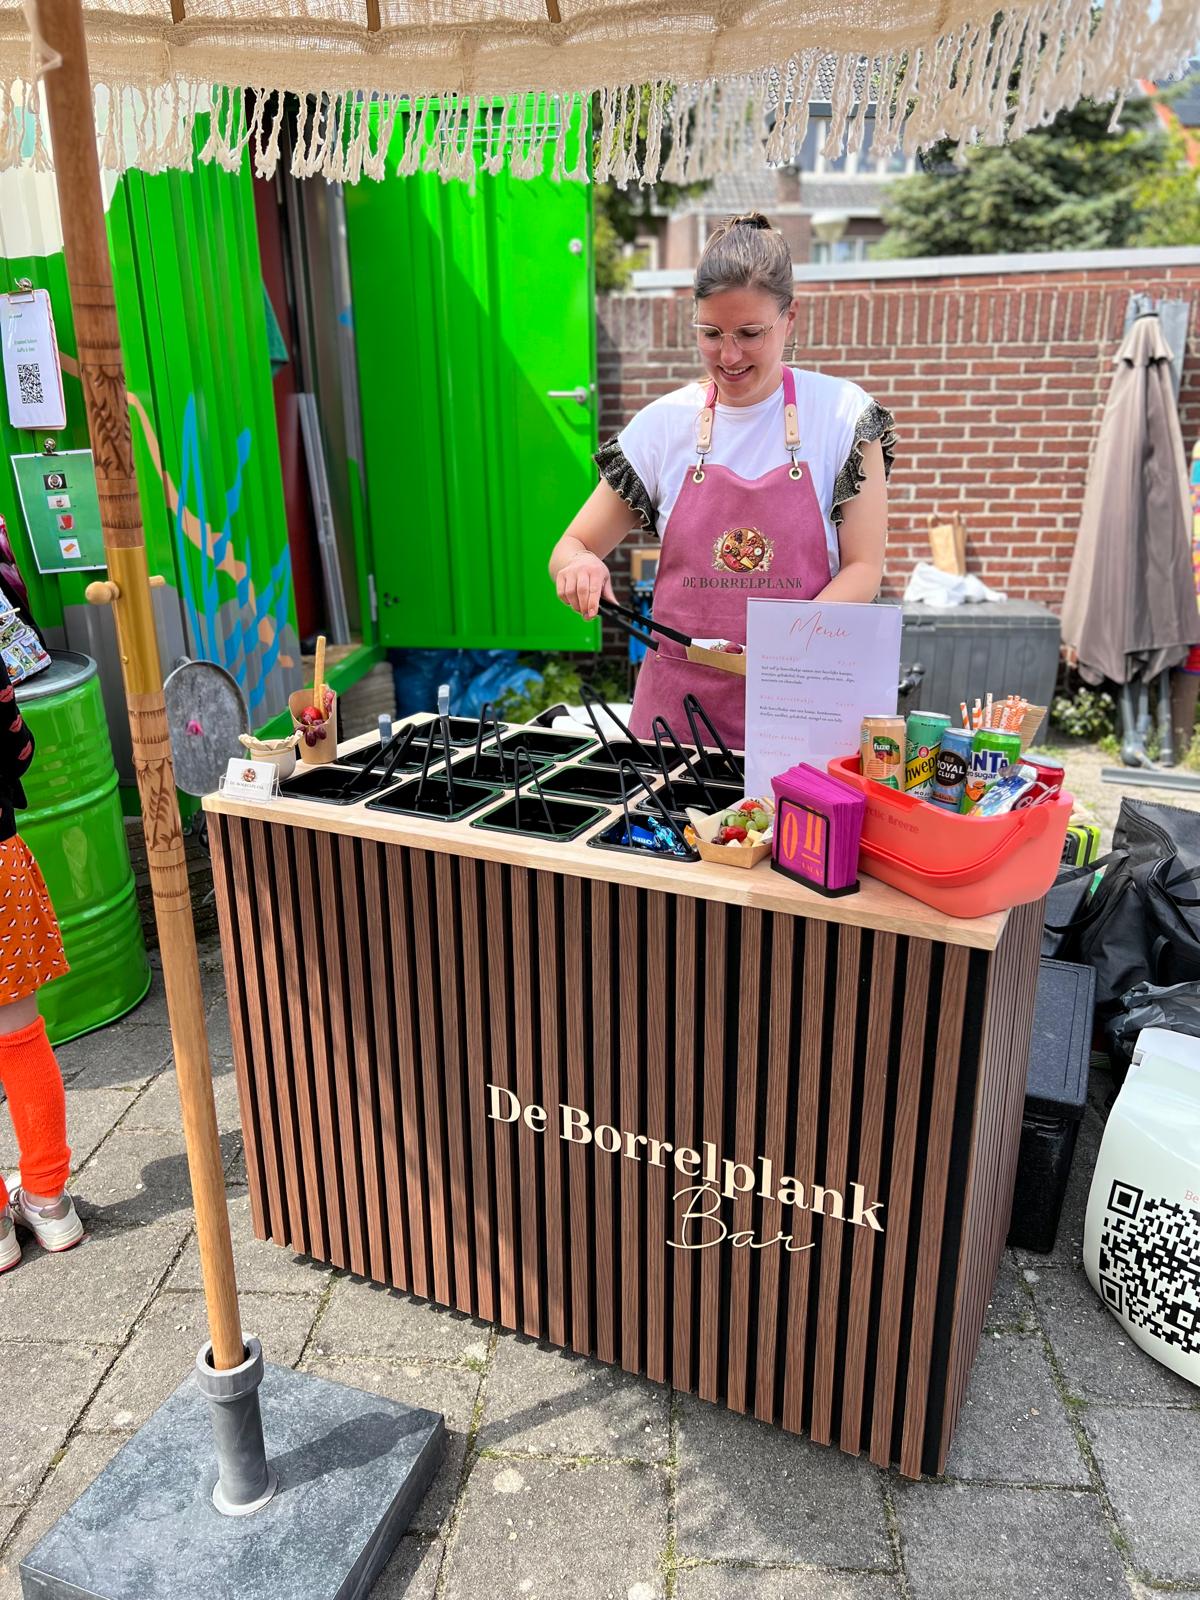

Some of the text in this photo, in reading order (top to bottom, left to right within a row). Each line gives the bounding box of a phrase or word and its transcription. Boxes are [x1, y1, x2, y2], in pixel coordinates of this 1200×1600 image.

[682, 577, 802, 588] DE BORRELPLANK
[789, 610, 851, 652] Menu
[873, 743, 890, 751] fuze
[968, 750, 1009, 774] NTA
[938, 771, 956, 780] CLUB
[974, 771, 997, 780] sugar
[486, 1083, 885, 1233] De Borrelplank
[1184, 1190, 1200, 1204] Be
[666, 1182, 816, 1252] Bar
